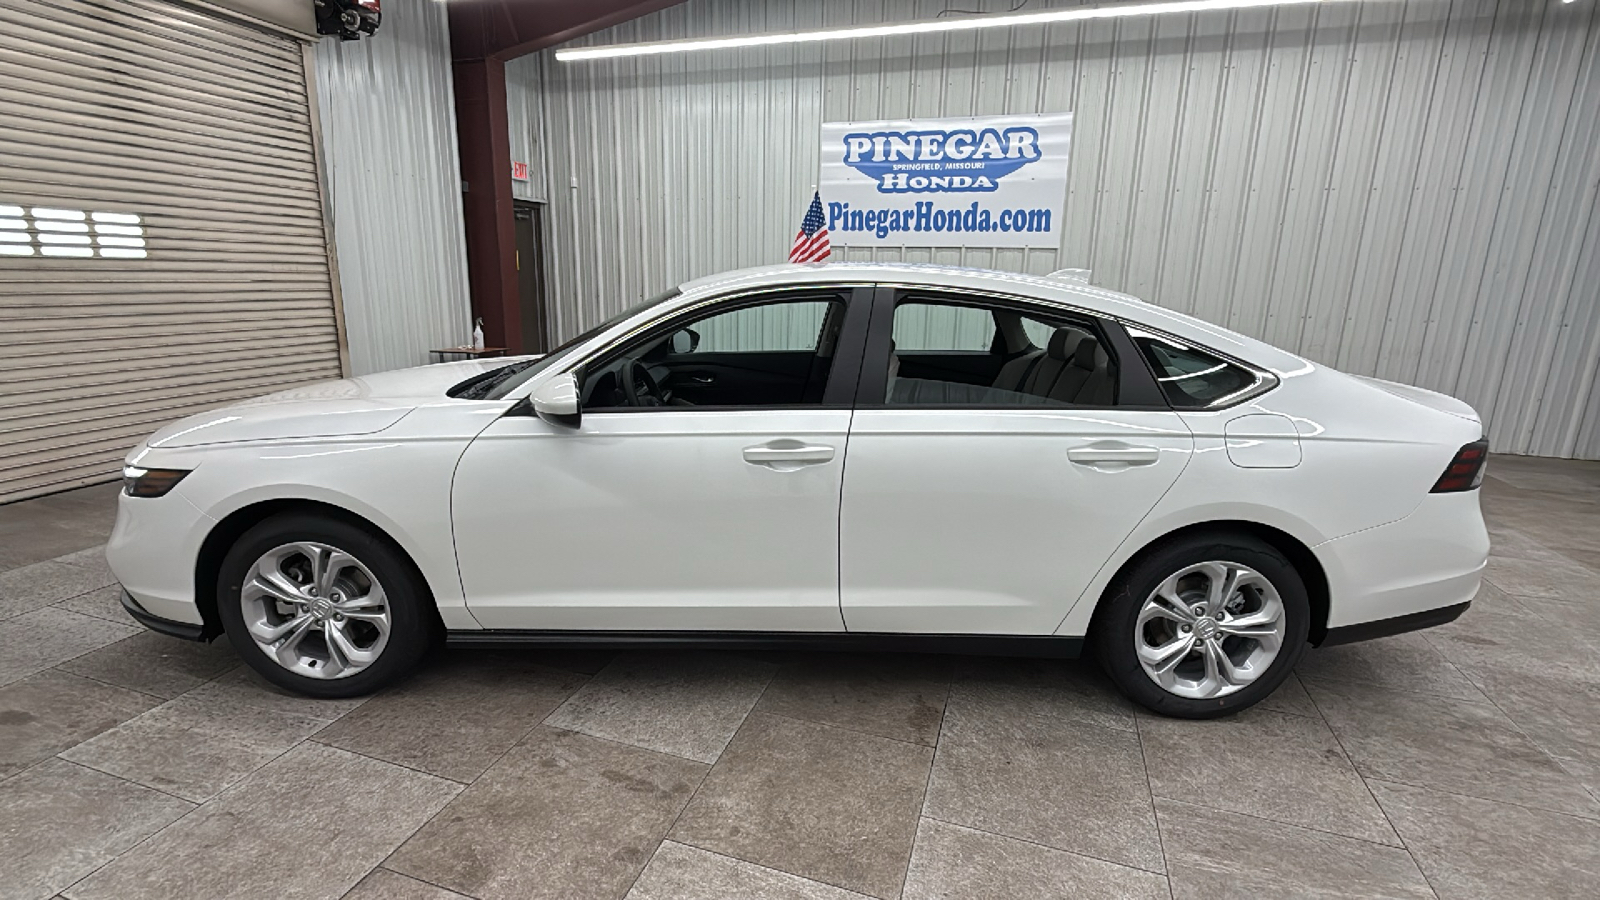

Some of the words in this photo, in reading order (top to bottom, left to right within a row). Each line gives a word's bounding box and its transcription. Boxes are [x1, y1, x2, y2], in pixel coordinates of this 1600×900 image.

[847, 131, 1037, 162] PINEGAR
[514, 161, 527, 179] EXIT
[892, 163, 942, 171] SPRINGFIELD,
[945, 162, 985, 170] MISSOURI
[881, 173, 994, 189] HONDA
[828, 202, 1051, 238] PinegarHonda.com
